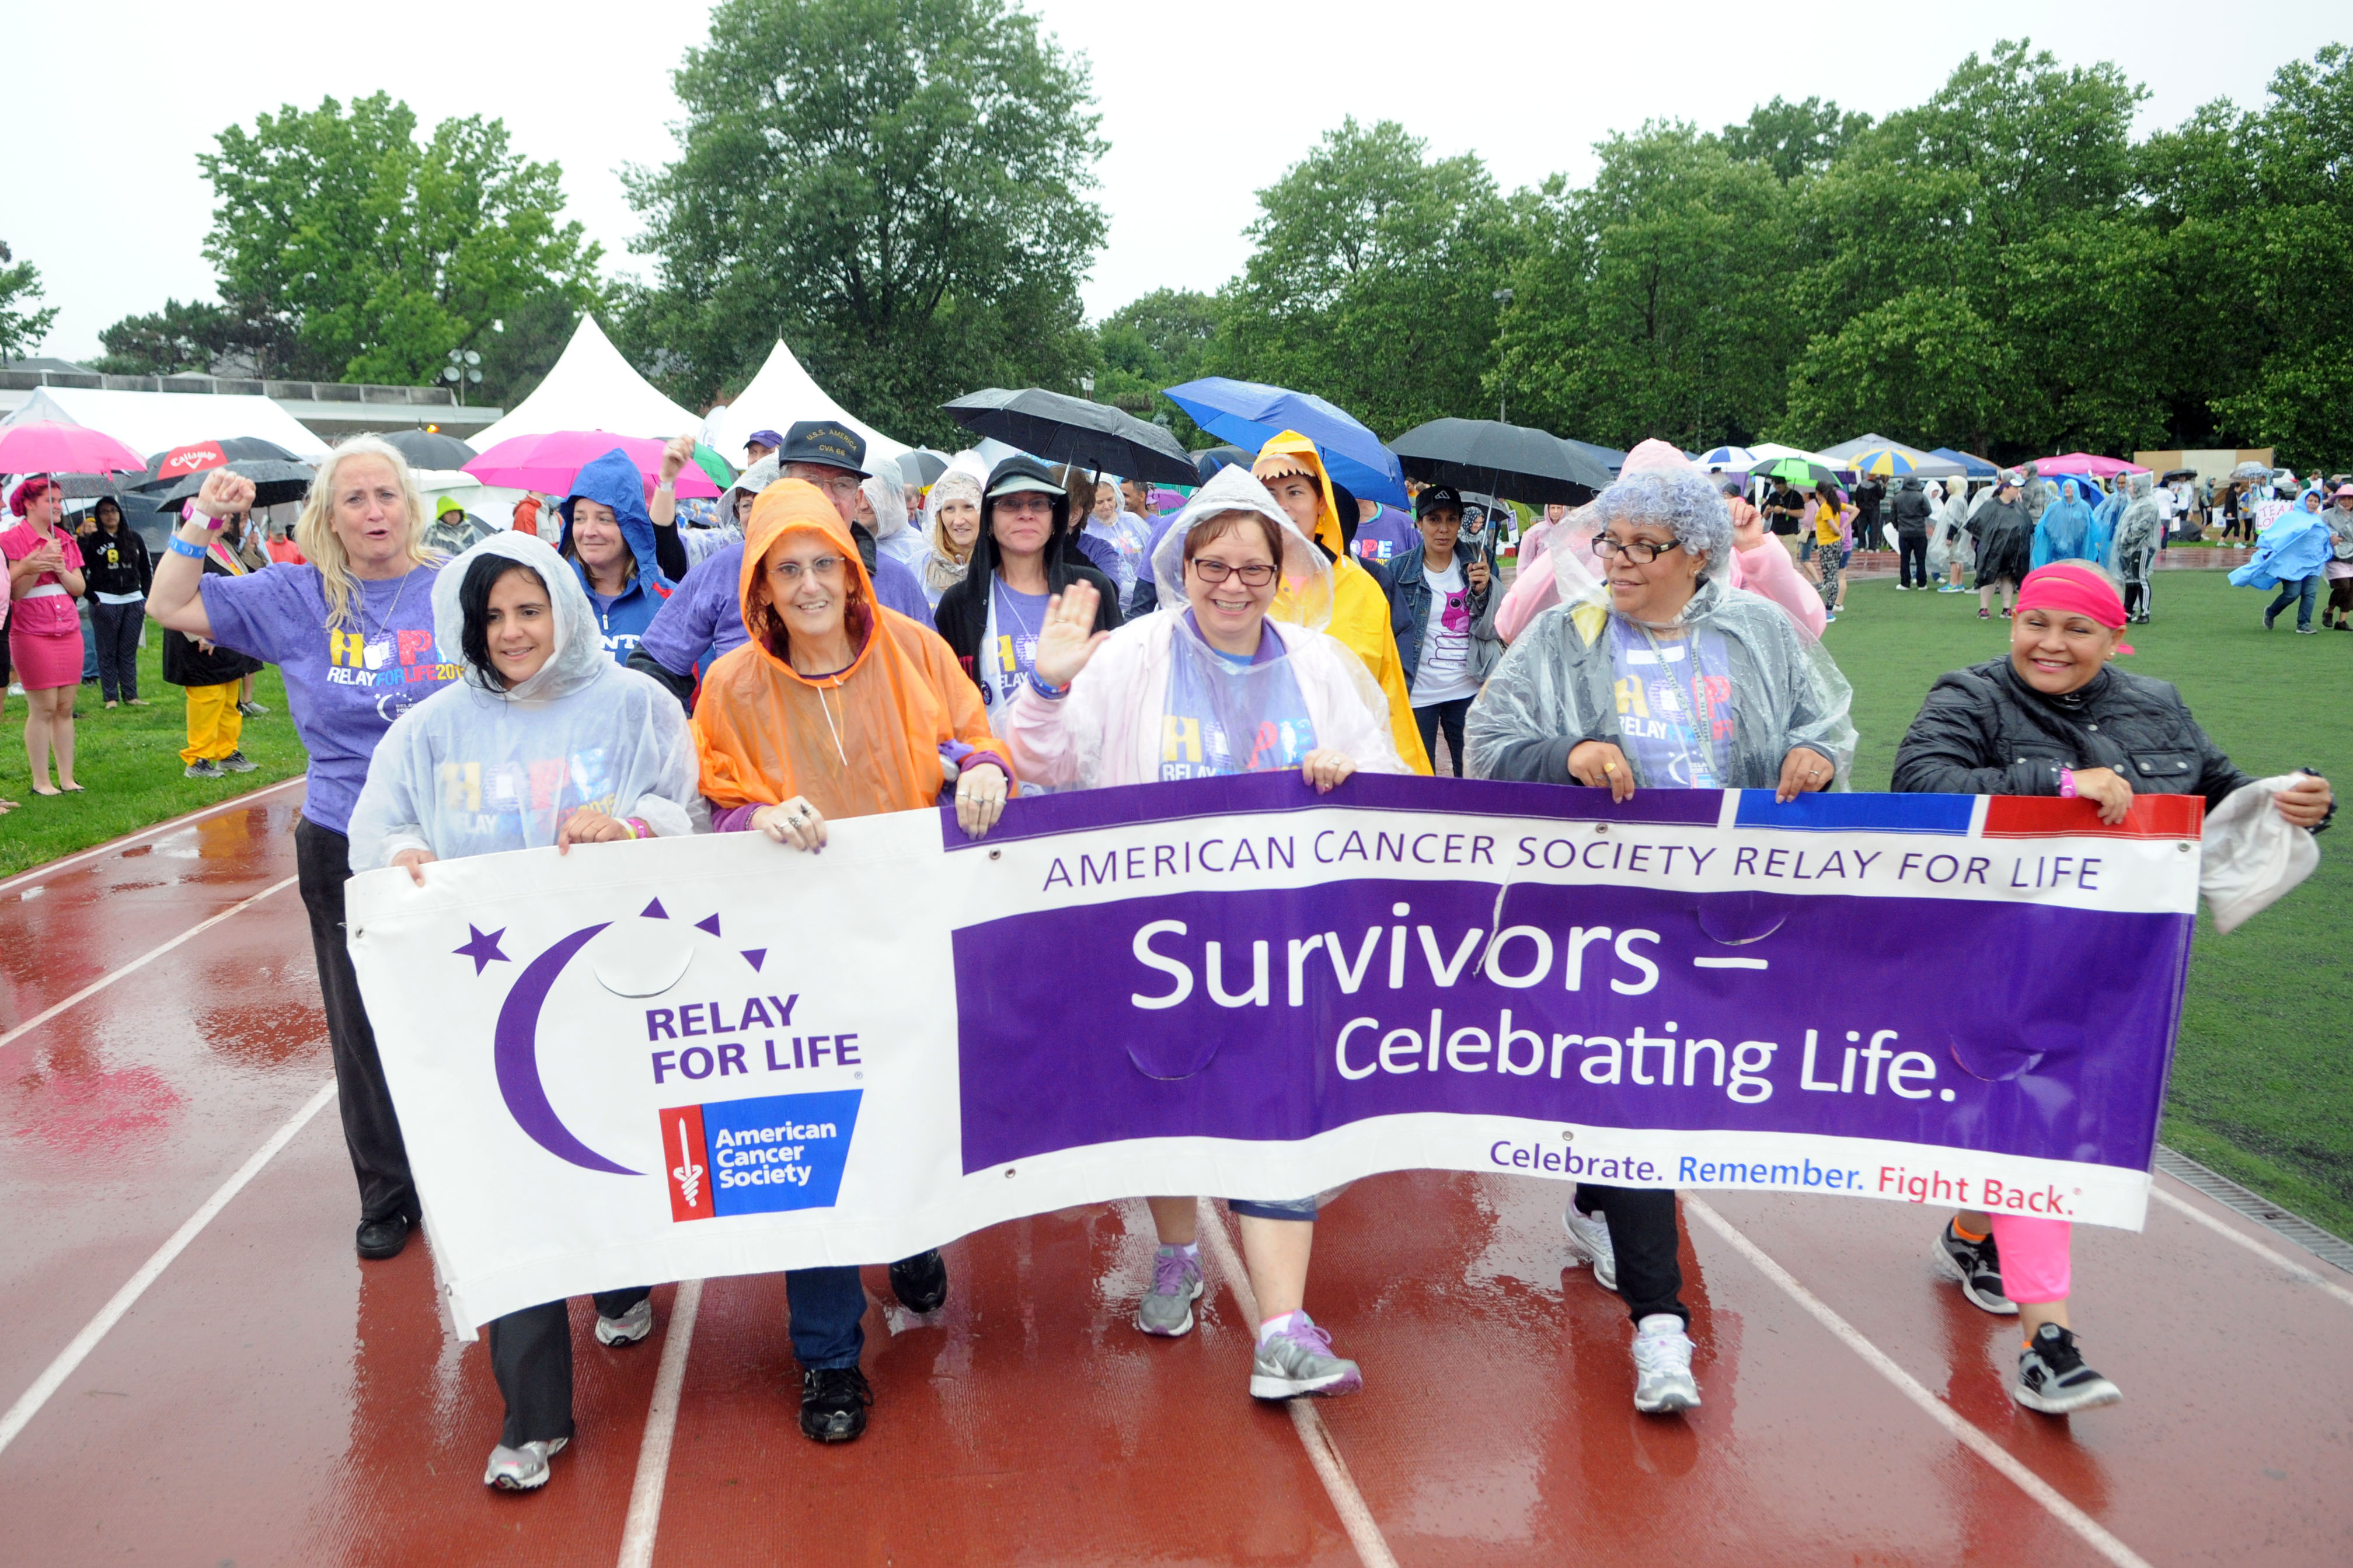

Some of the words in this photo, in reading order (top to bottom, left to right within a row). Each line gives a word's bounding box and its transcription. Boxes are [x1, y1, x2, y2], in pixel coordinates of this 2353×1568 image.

[819, 445, 834, 453] CVA
[829, 429, 857, 452] AMERICA
[1350, 539, 1393, 558] OPE
[600, 635, 640, 649] NT
[1000, 671, 1029, 689] ELAY
[1043, 836, 1295, 892] AMERICAN
[1314, 830, 1495, 865] CANCER
[1516, 837, 1717, 876] SOCIETY
[1733, 846, 1883, 879] RELAY
[1897, 852, 1991, 885] FOR
[2010, 855, 2102, 890] LIFE
[1131, 902, 1661, 1010] Survivors
[646, 993, 800, 1042] RELAY
[651, 1043, 749, 1084] FOR
[765, 1033, 862, 1071] LIFE
[1335, 1008, 1778, 1103] Celebrating
[1800, 1029, 1955, 1102] Life.
[715, 1121, 836, 1148] American
[717, 1145, 805, 1168] Cancer
[719, 1164, 812, 1189] Society
[1490, 1140, 1663, 1181] Celebrate.
[1679, 1156, 1864, 1190] Remember.
[1878, 1166, 1969, 1204] Fight
